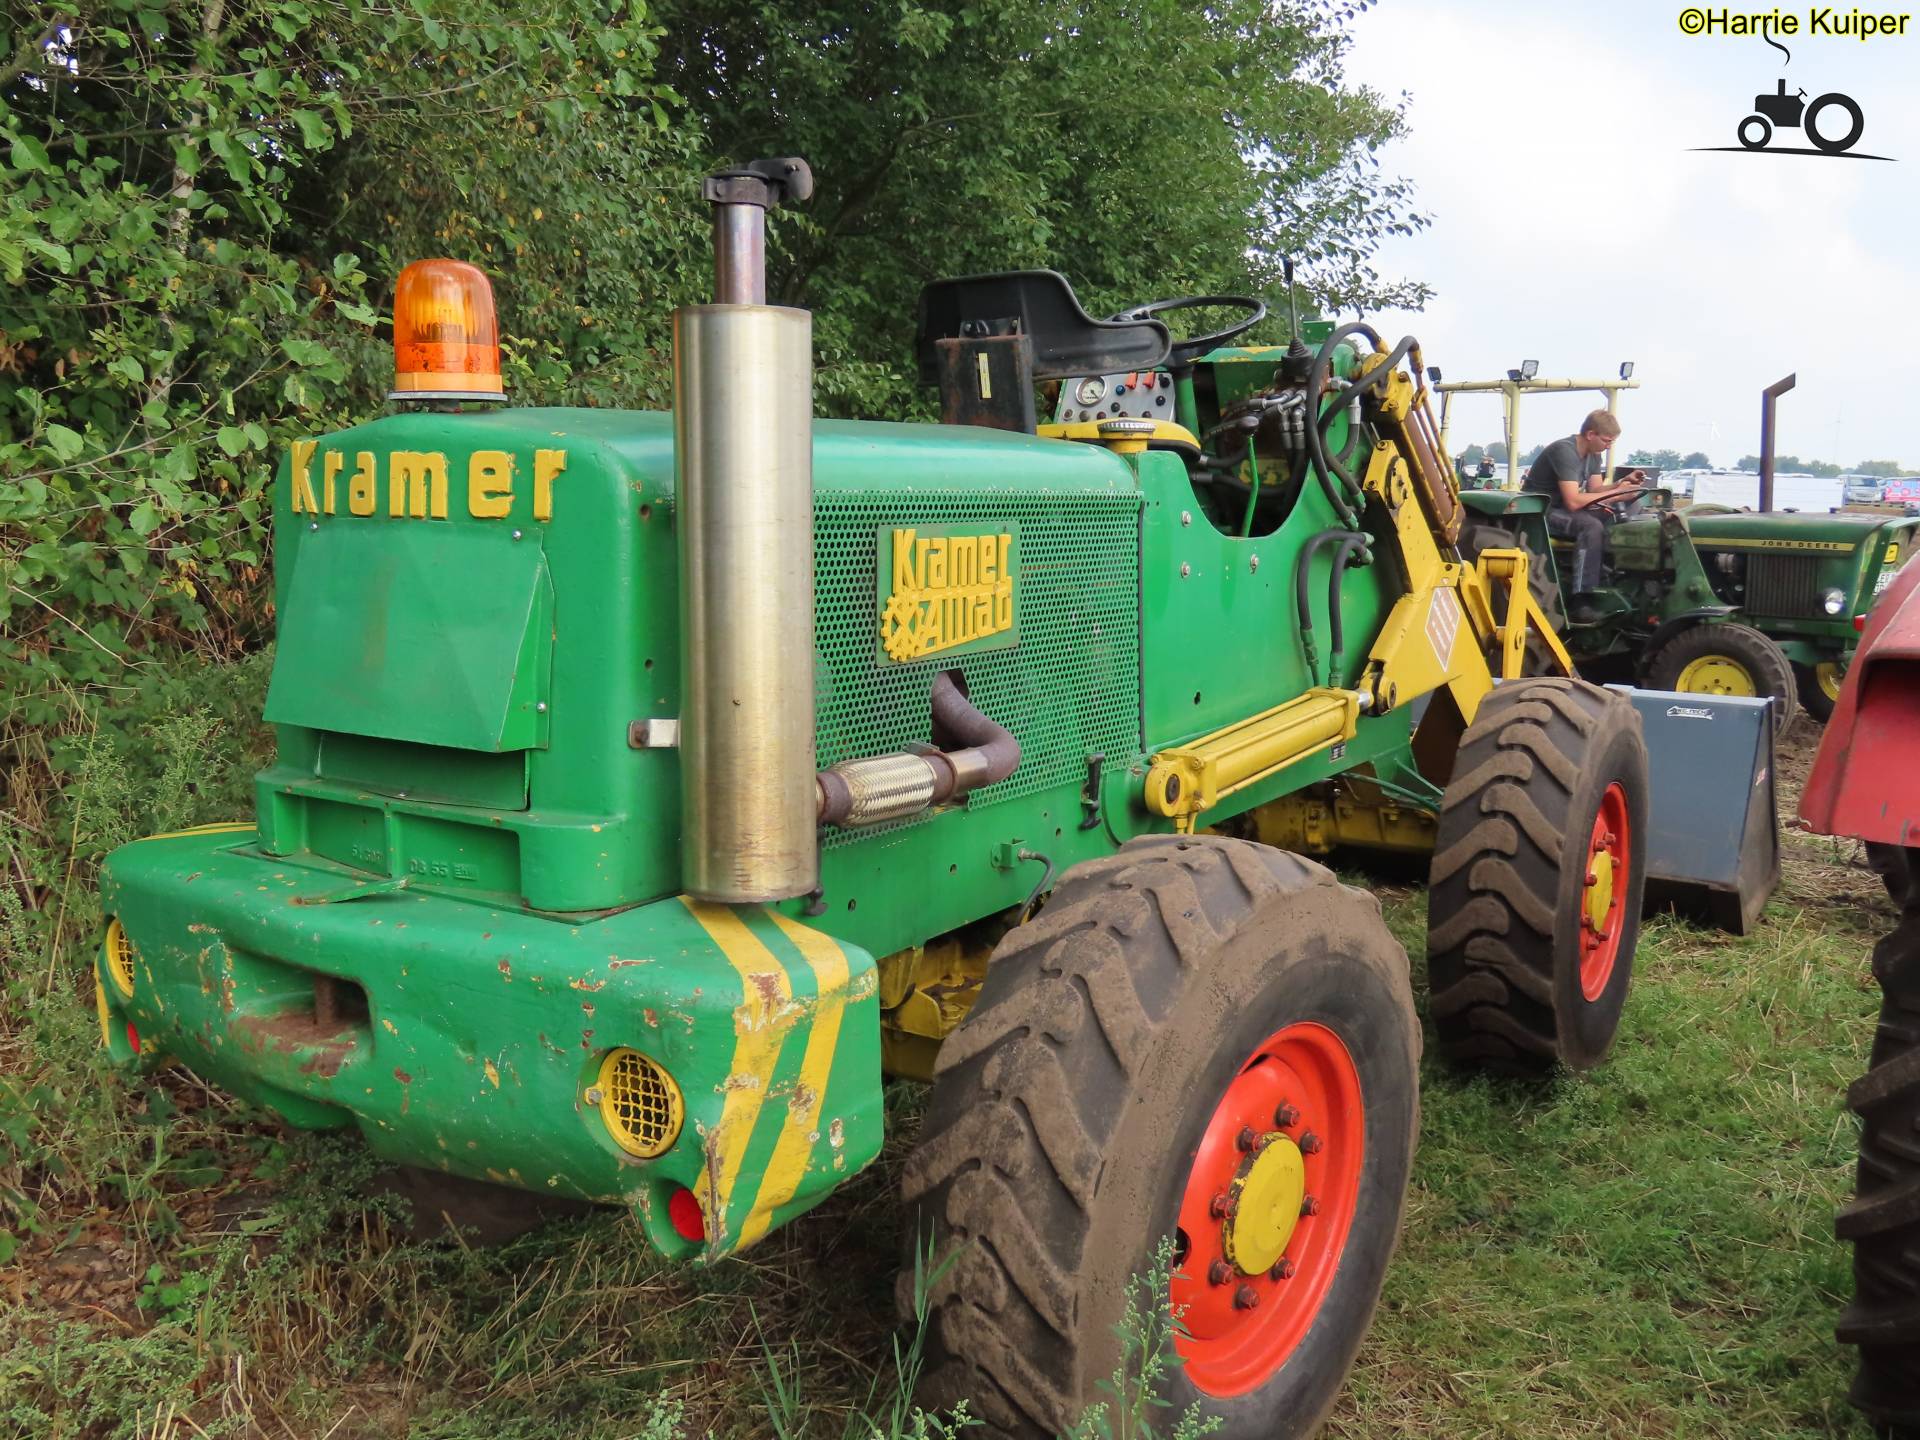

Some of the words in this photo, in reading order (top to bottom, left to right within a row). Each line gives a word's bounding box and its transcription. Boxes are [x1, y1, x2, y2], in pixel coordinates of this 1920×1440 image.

[291, 439, 567, 523] Kramer
[893, 528, 1012, 592] Kramer
[1760, 540, 1792, 548] JOHN
[1798, 541, 1840, 550] DEERE
